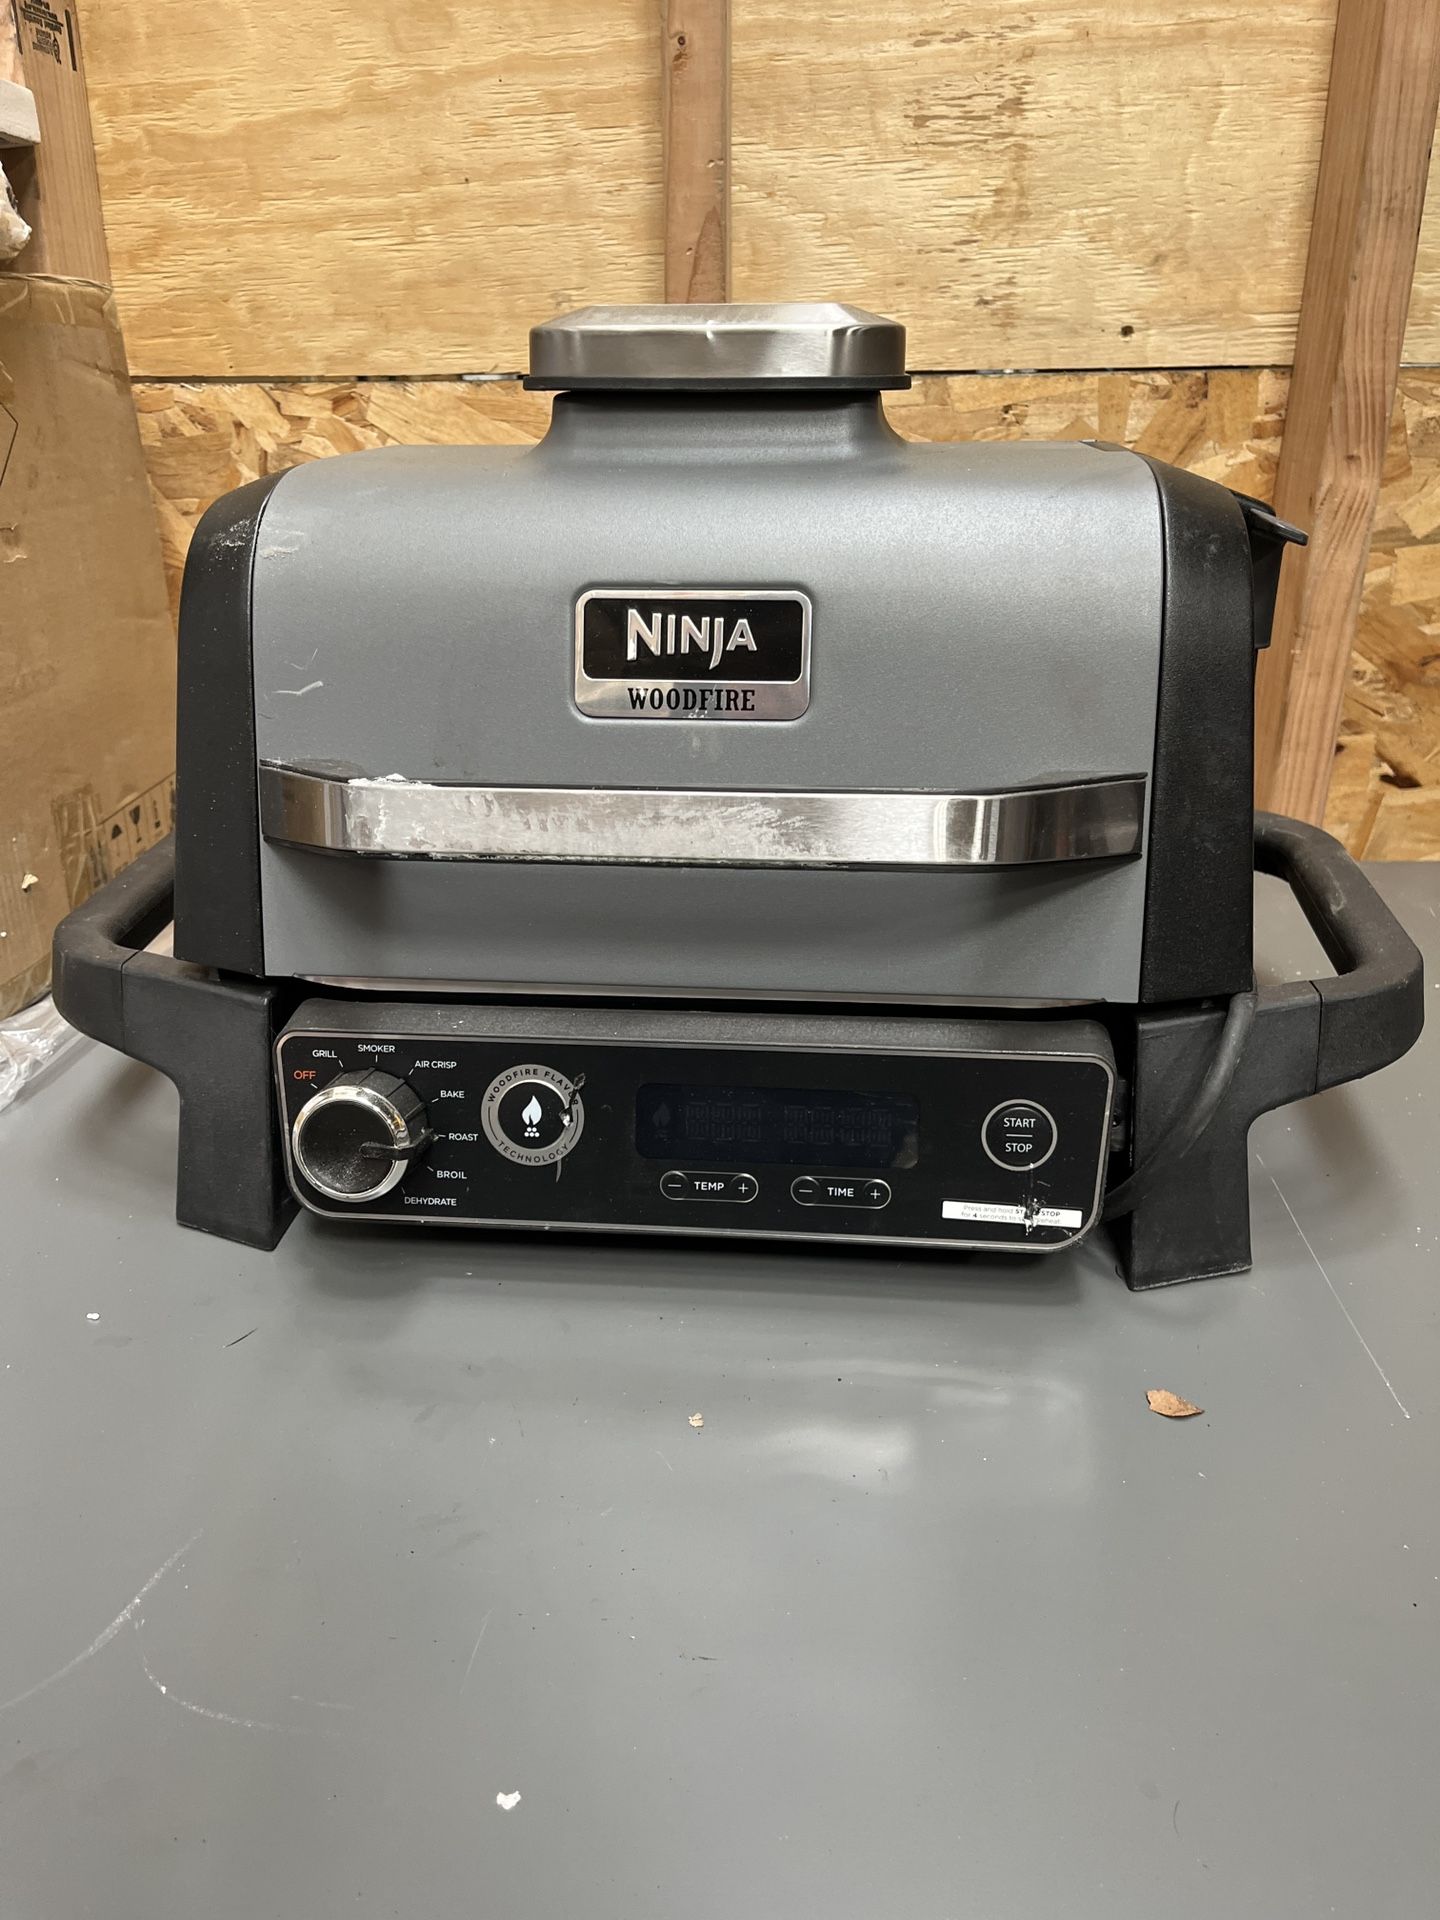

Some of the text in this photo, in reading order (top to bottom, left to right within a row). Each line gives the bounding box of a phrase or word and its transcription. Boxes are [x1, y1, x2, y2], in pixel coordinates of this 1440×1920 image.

[626, 608, 758, 671] NINJA
[627, 687, 756, 712] WOODFIRE
[312, 1049, 338, 1059] GRILL
[357, 1044, 396, 1054] SMOKER
[414, 1060, 457, 1070] AIR CRISP
[293, 1070, 317, 1081] OFF
[487, 1068, 538, 1102] WOODFIRE
[440, 1090, 465, 1099] BAKE
[1003, 1117, 1036, 1129] START
[448, 1133, 479, 1142] ROAST
[497, 1141, 569, 1163] TECHNOLOGY
[1005, 1143, 1033, 1153] STOP
[436, 1170, 467, 1179] BROIL
[694, 1181, 725, 1192] TEMP
[827, 1187, 854, 1197] TIME
[404, 1196, 457, 1206] DEHYDRATE
